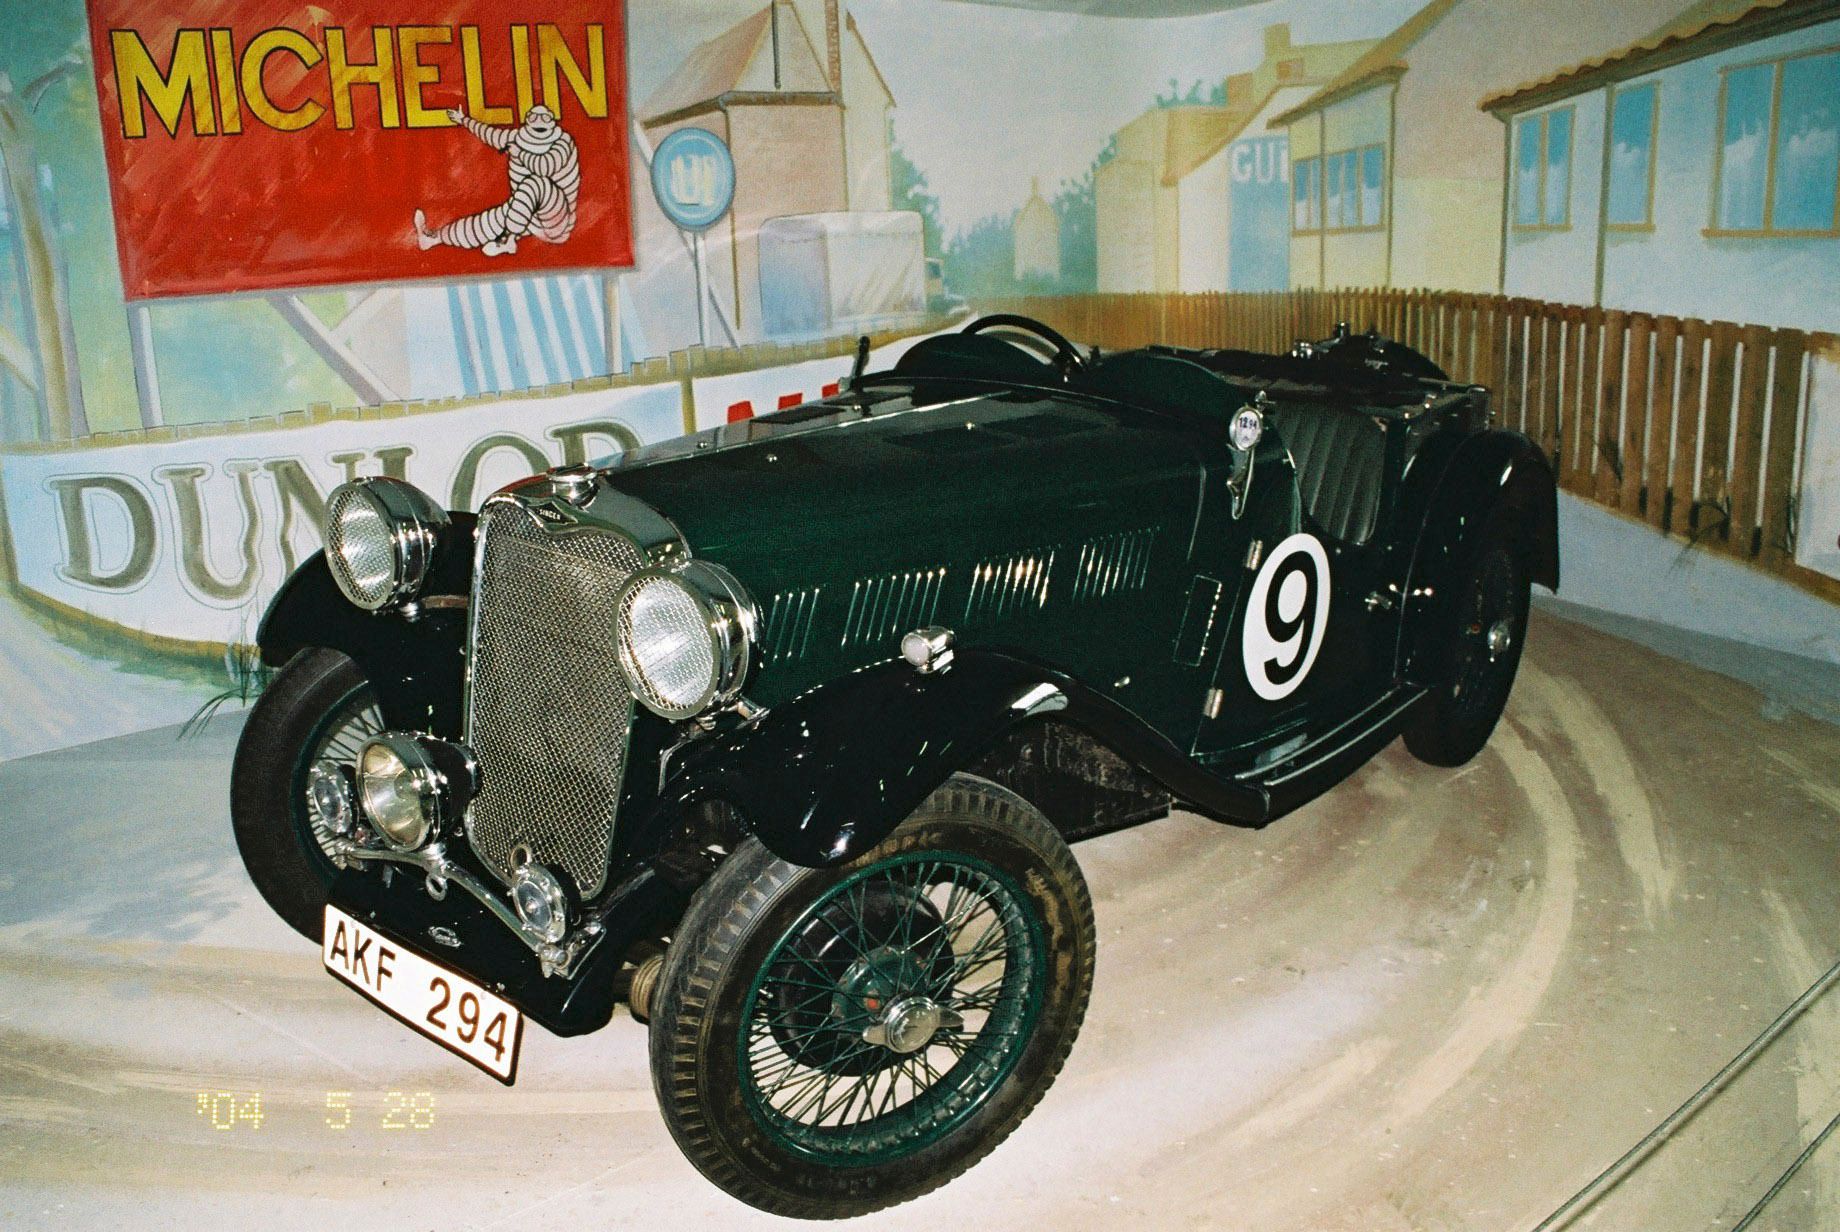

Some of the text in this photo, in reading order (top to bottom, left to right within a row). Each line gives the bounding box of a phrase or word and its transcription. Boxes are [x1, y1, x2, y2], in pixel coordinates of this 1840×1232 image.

[110, 23, 610, 139] MICHELIN
[1264, 550, 1318, 685] 9
[330, 920, 508, 1062] AKF 294
